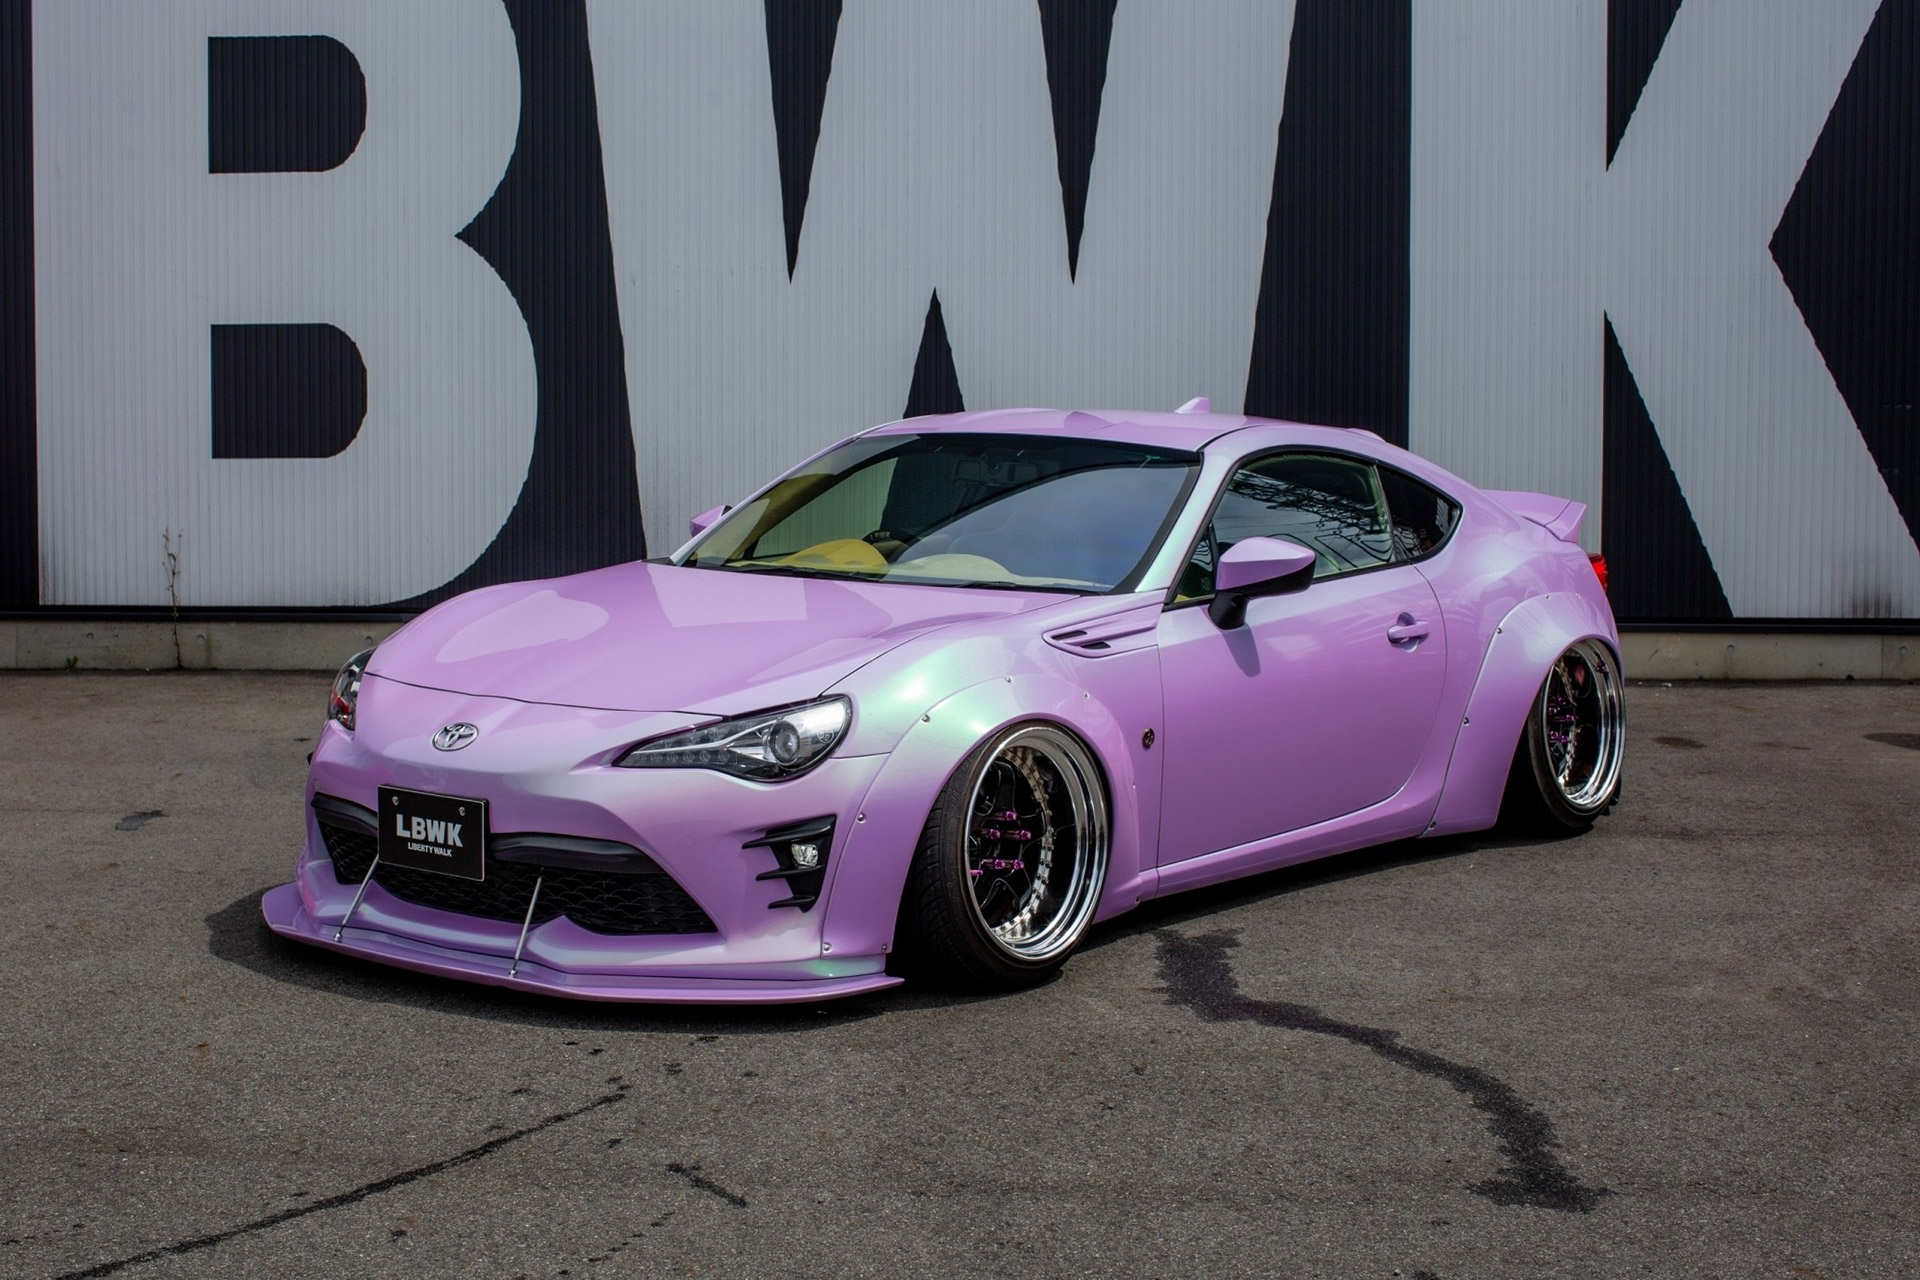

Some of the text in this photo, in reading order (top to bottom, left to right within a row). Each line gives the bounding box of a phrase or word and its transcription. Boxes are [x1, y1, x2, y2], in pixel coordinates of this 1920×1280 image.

[31, 0, 1920, 618] BWK
[396, 813, 463, 847] LBWK
[408, 842, 452, 857] LIBERTY WALK
